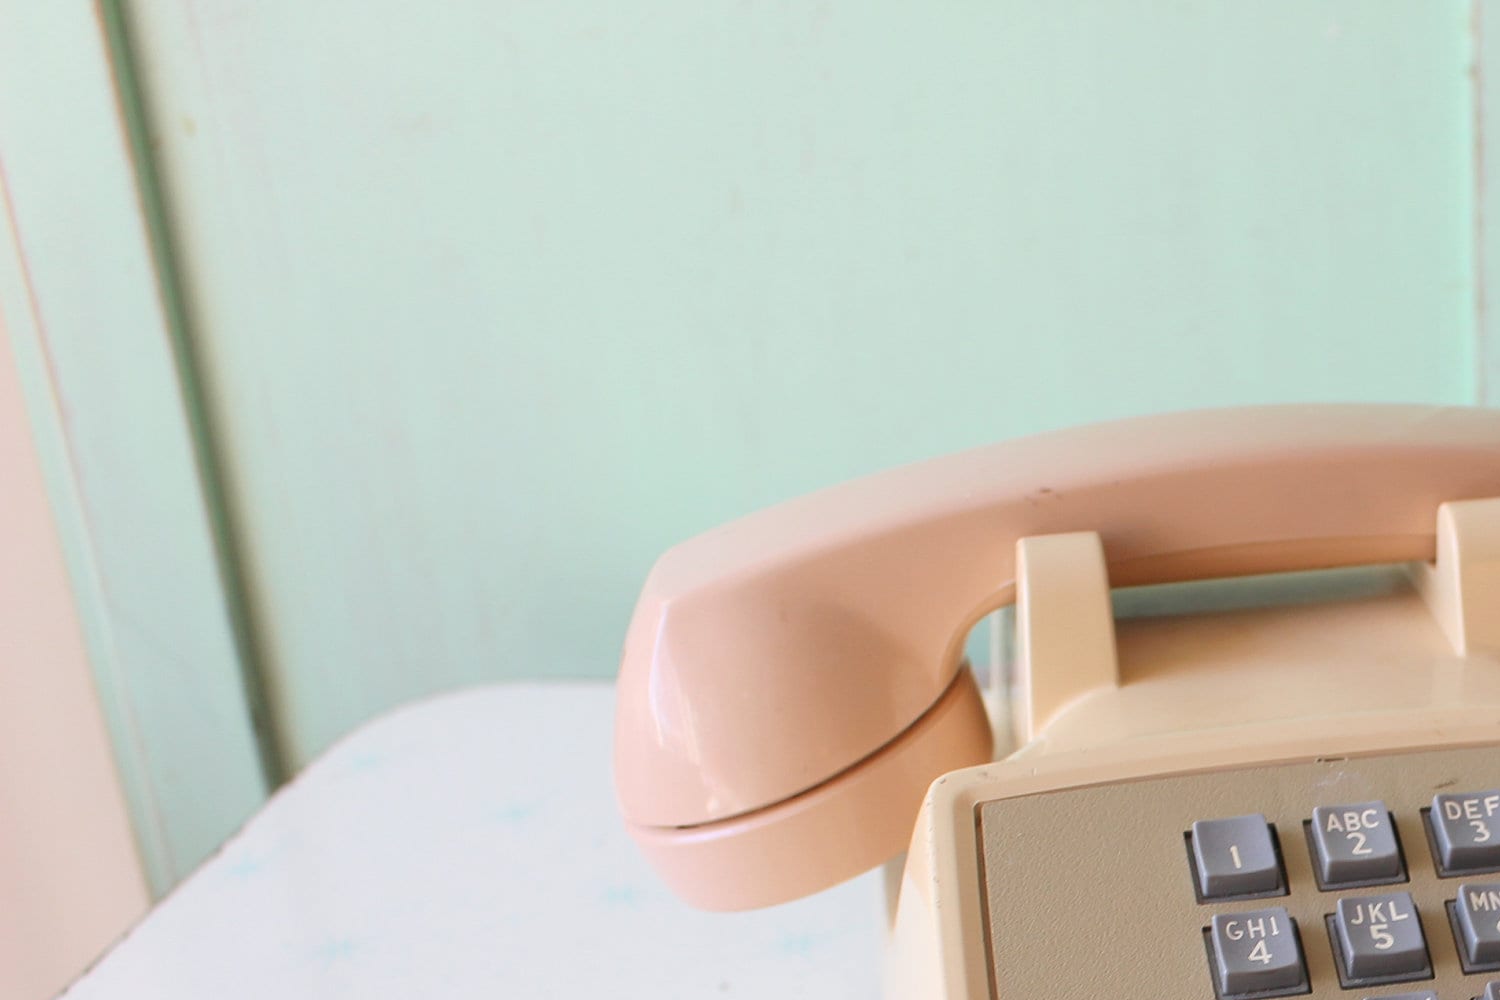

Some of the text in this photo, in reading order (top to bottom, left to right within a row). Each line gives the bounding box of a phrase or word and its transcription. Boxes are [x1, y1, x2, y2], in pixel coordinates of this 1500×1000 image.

[1326, 808, 1380, 833] ABC
[1444, 795, 1500, 821] DEF
[1346, 832, 1373, 856] 2
[1469, 820, 1491, 843] 3
[1350, 901, 1409, 925] JKL
[1225, 916, 1280, 941] GHI
[1371, 924, 1395, 950] 5
[1247, 940, 1273, 965] 4
